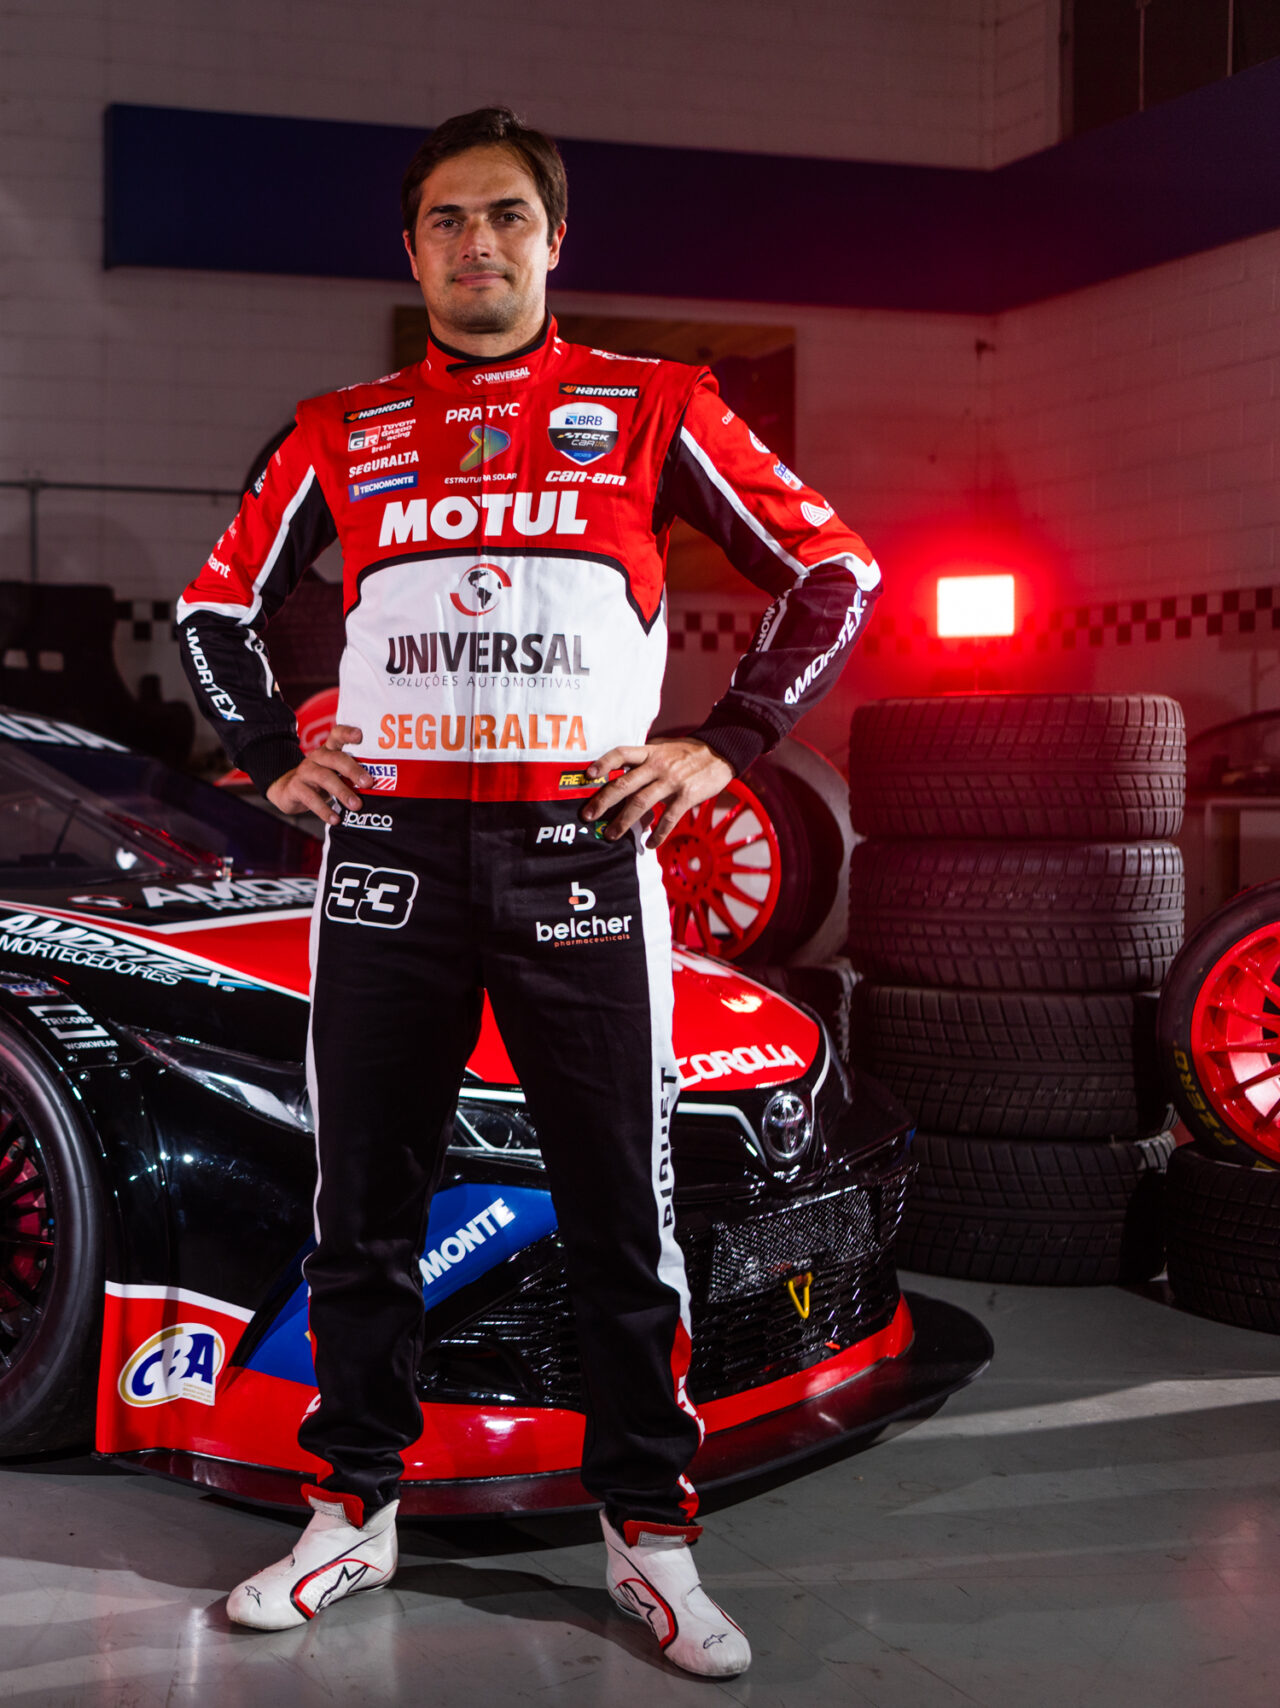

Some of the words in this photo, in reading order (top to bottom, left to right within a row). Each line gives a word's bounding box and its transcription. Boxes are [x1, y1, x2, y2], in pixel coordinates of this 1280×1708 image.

[485, 366, 530, 381] UNIVERSAL
[383, 419, 416, 430] TOYOTA
[578, 415, 602, 426] BRB
[349, 450, 419, 478] SEGURALTA
[360, 475, 414, 494] TECNOMONTE
[492, 473, 518, 481] SOLAR
[545, 470, 627, 486] can-am
[378, 490, 588, 547] MOTUL
[385, 632, 590, 676] UNIVERSAL
[186, 627, 245, 721] AMORTEX
[387, 673, 460, 690] SOLUÇÕES
[466, 675, 581, 691] AUTOMOTIVAS
[378, 713, 587, 752] SEGURALTA
[325, 861, 419, 930] 33
[536, 915, 632, 942] belcher
[554, 933, 631, 948] pharmaceuticals
[40, 1015, 95, 1026] TRICORP
[63, 1040, 120, 1050] WORKWEAR
[675, 1044, 806, 1091] COROLLA
[417, 1198, 517, 1288] MONTE
[131, 1333, 215, 1397] CBA
